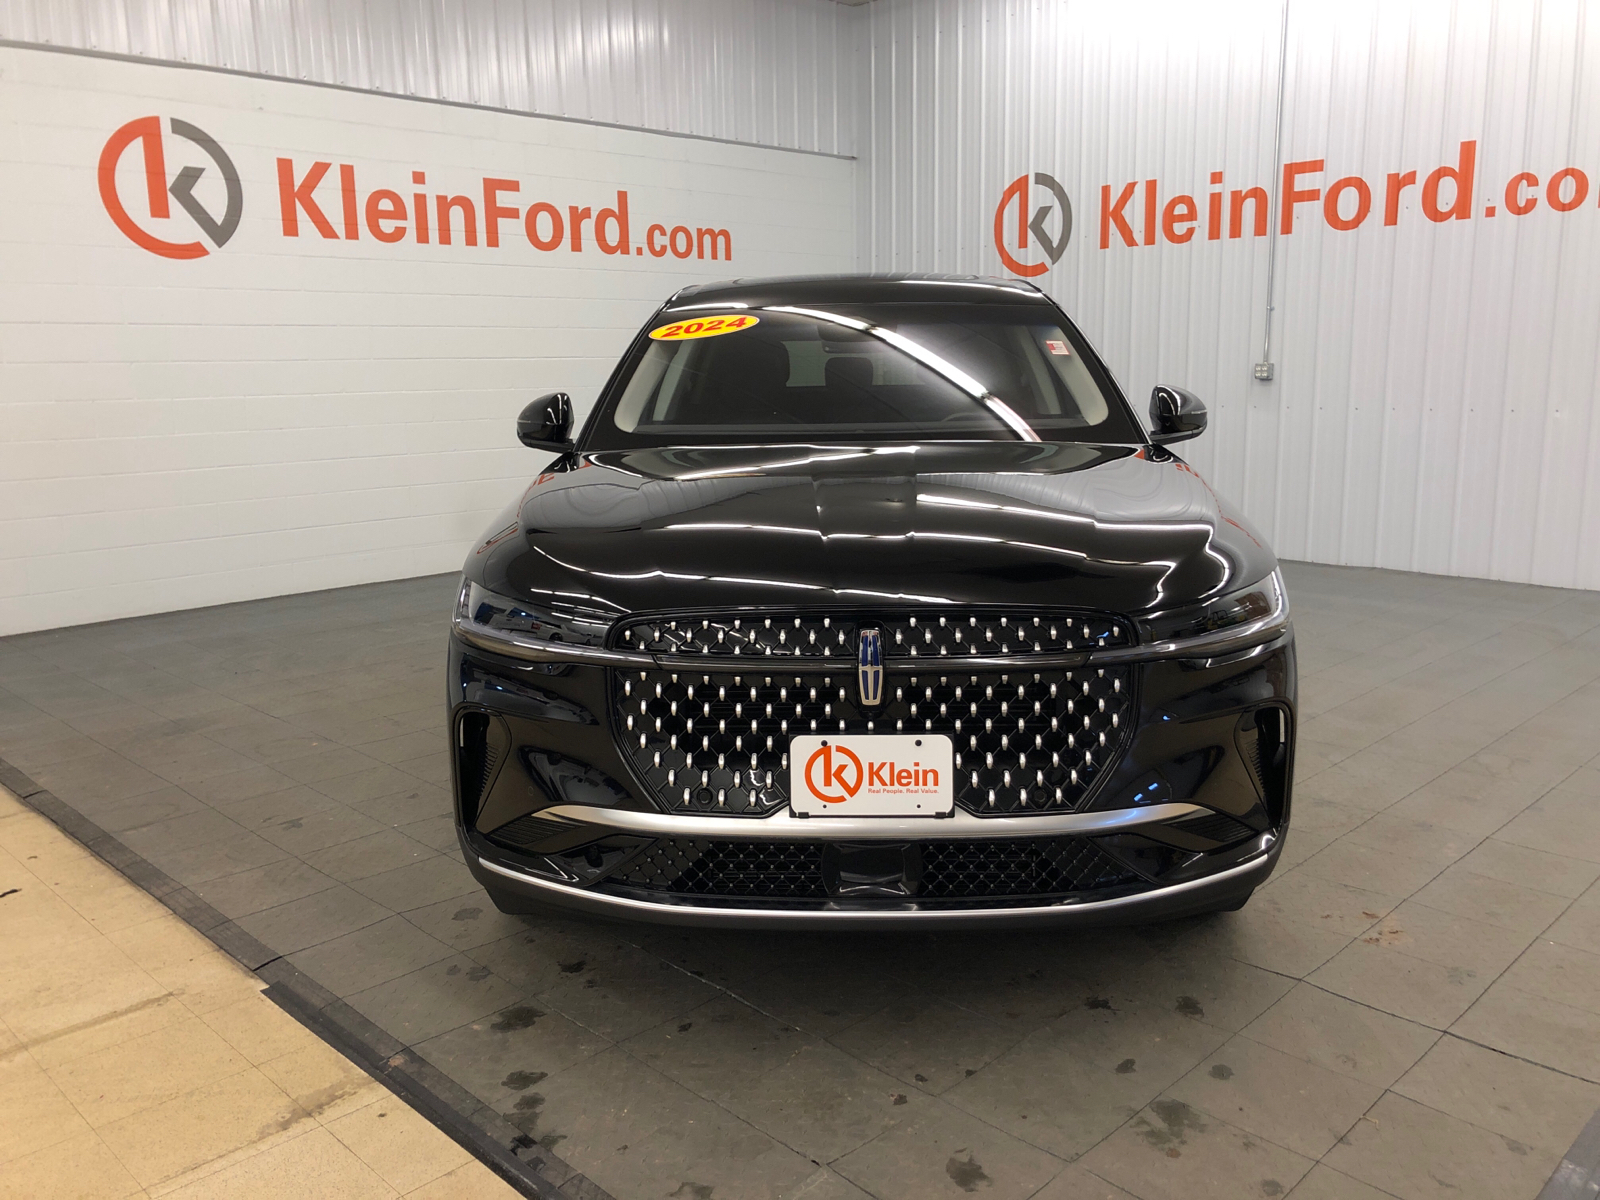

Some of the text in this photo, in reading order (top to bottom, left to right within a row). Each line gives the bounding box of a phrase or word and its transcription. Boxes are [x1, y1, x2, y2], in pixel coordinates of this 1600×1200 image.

[276, 157, 733, 261] KleinFord.com
[1099, 140, 1600, 250] KleinFord.co
[660, 316, 748, 338] 2024
[867, 761, 939, 787] Klein
